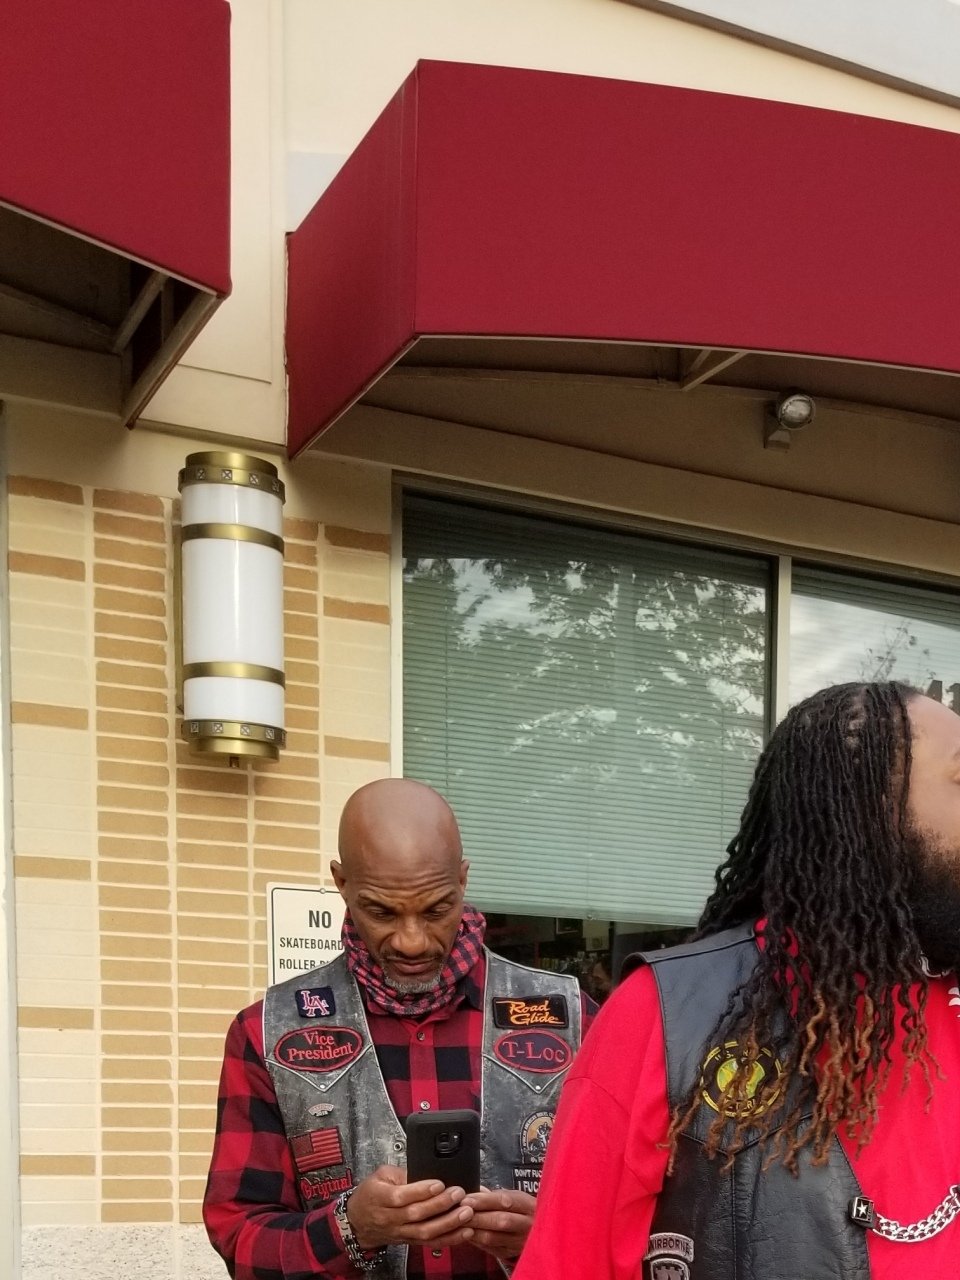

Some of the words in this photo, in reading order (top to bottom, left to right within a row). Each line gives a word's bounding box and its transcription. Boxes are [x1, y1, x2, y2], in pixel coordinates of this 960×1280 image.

[308, 910, 332, 928] NO
[279, 957, 317, 971] ROLLER
[301, 990, 330, 1017] LA
[496, 1000, 550, 1015] Road
[510, 1012, 565, 1025] Glide
[303, 1031, 335, 1046] Vice
[287, 1042, 354, 1062] President
[648, 1238, 691, 1256] AIRBORNE
